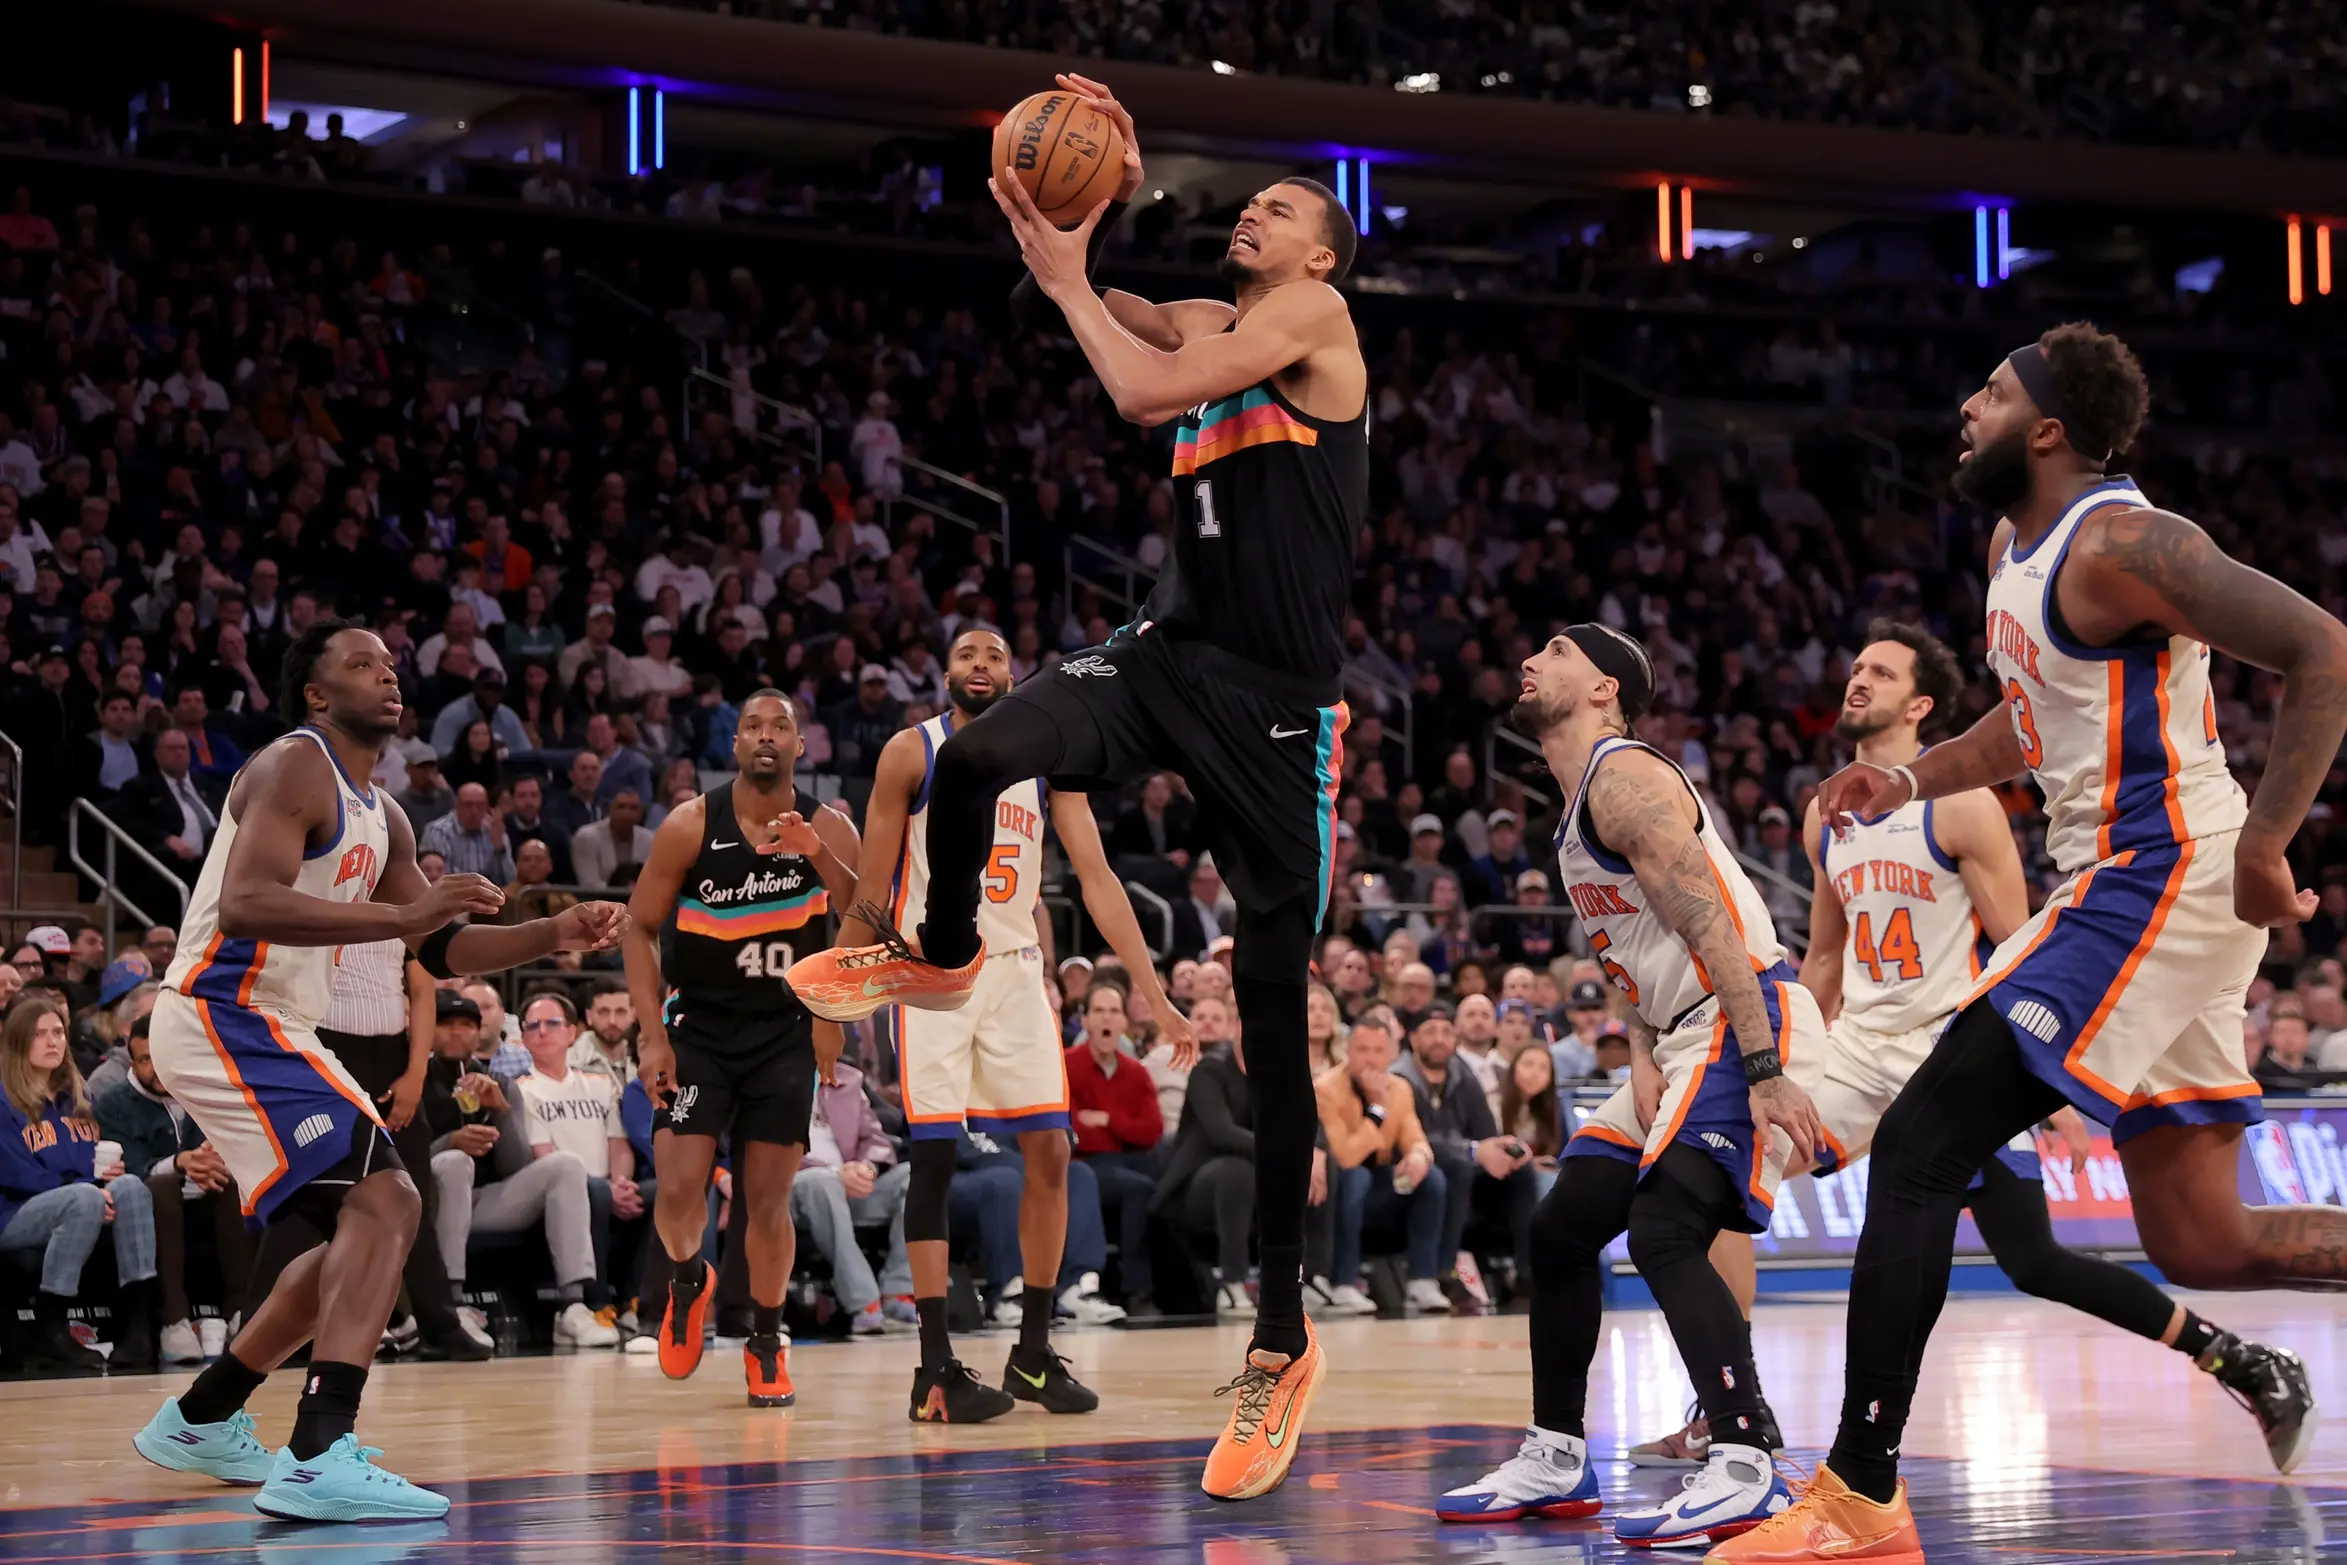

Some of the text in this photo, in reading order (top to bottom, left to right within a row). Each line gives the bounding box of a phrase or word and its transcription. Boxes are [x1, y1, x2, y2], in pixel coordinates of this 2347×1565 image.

[1015, 95, 1067, 171] Wilson
[1194, 479, 1222, 538] 1
[1999, 609, 2046, 688] YORK
[2001, 676, 2044, 772] 3
[994, 800, 1037, 842] ORK
[699, 869, 804, 904] San Antonio
[1569, 882, 1641, 921] YORK
[1868, 860, 1938, 904] YORK
[735, 941, 795, 978] 40
[1855, 907, 1924, 982] 44
